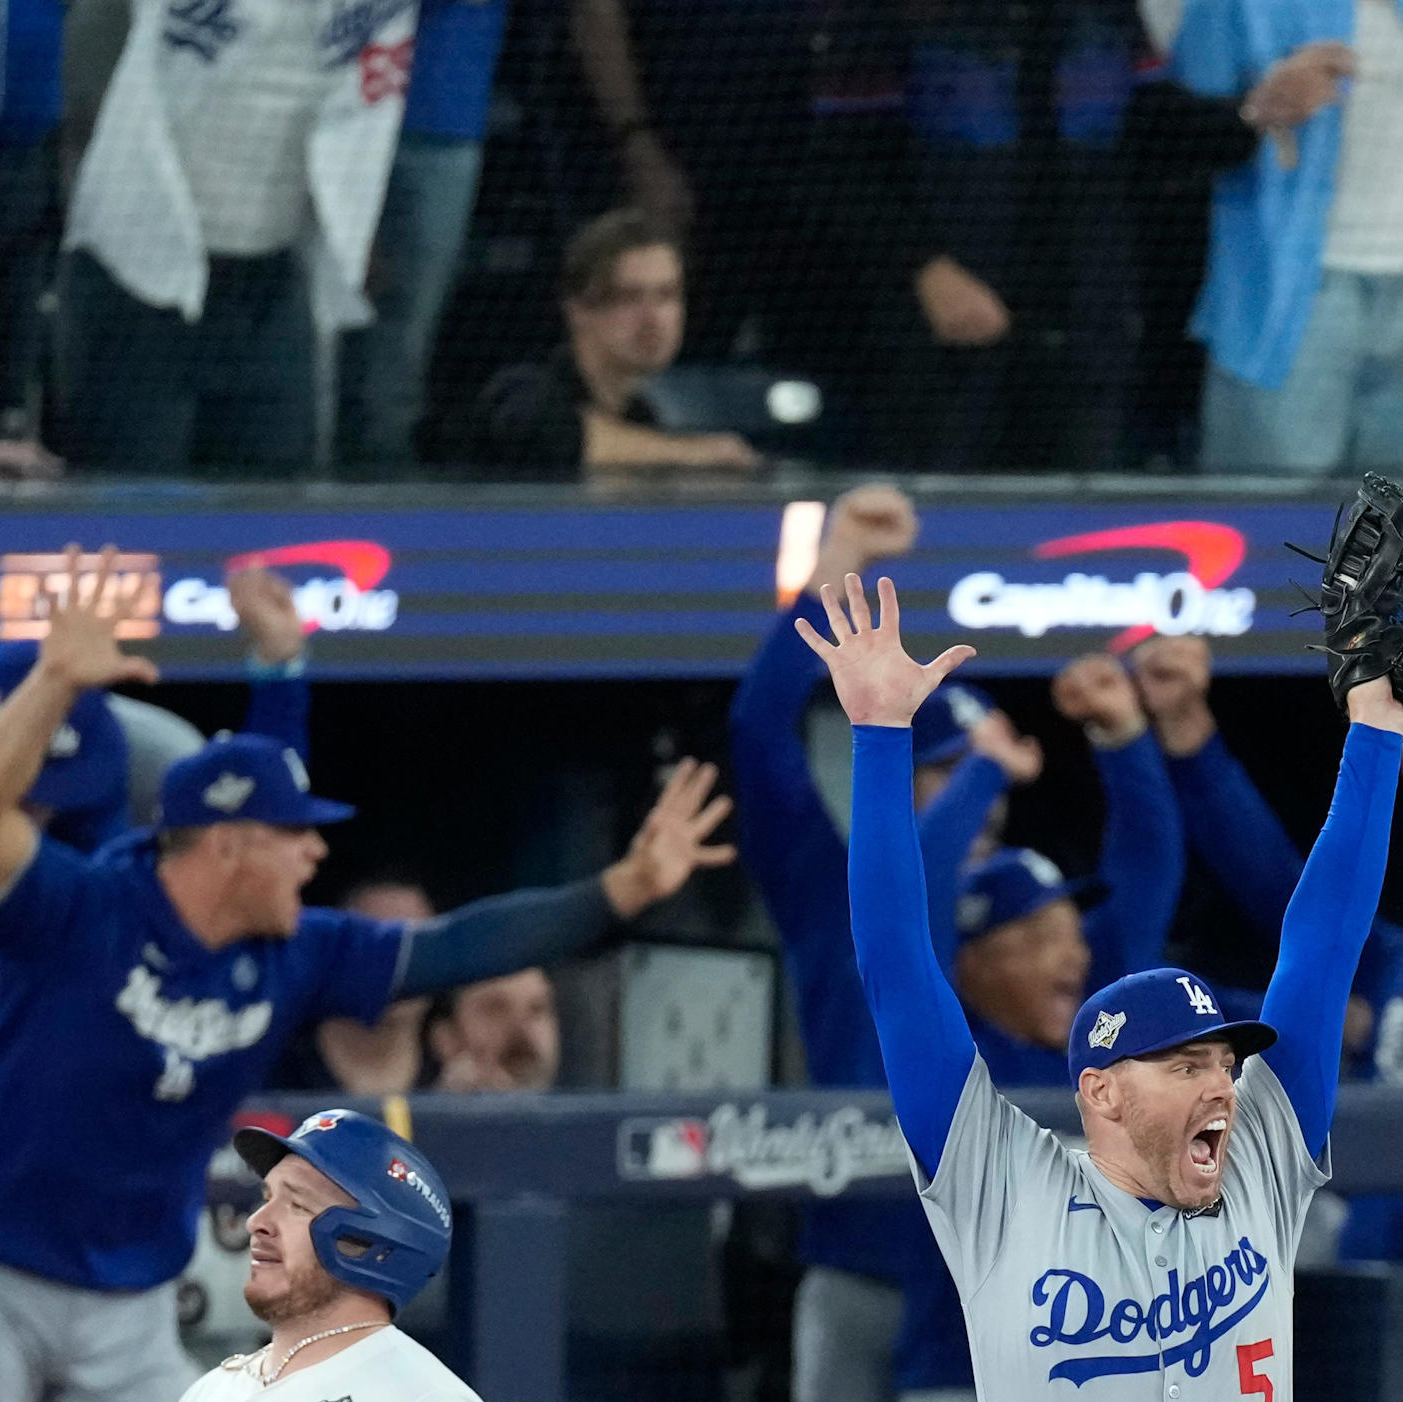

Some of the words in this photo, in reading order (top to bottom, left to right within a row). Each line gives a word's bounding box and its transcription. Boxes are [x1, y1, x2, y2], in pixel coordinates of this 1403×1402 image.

[1176, 976, 1218, 1015] LA
[406, 1171, 450, 1228] STRAUSS
[1030, 1236, 1269, 1387] Dodgers
